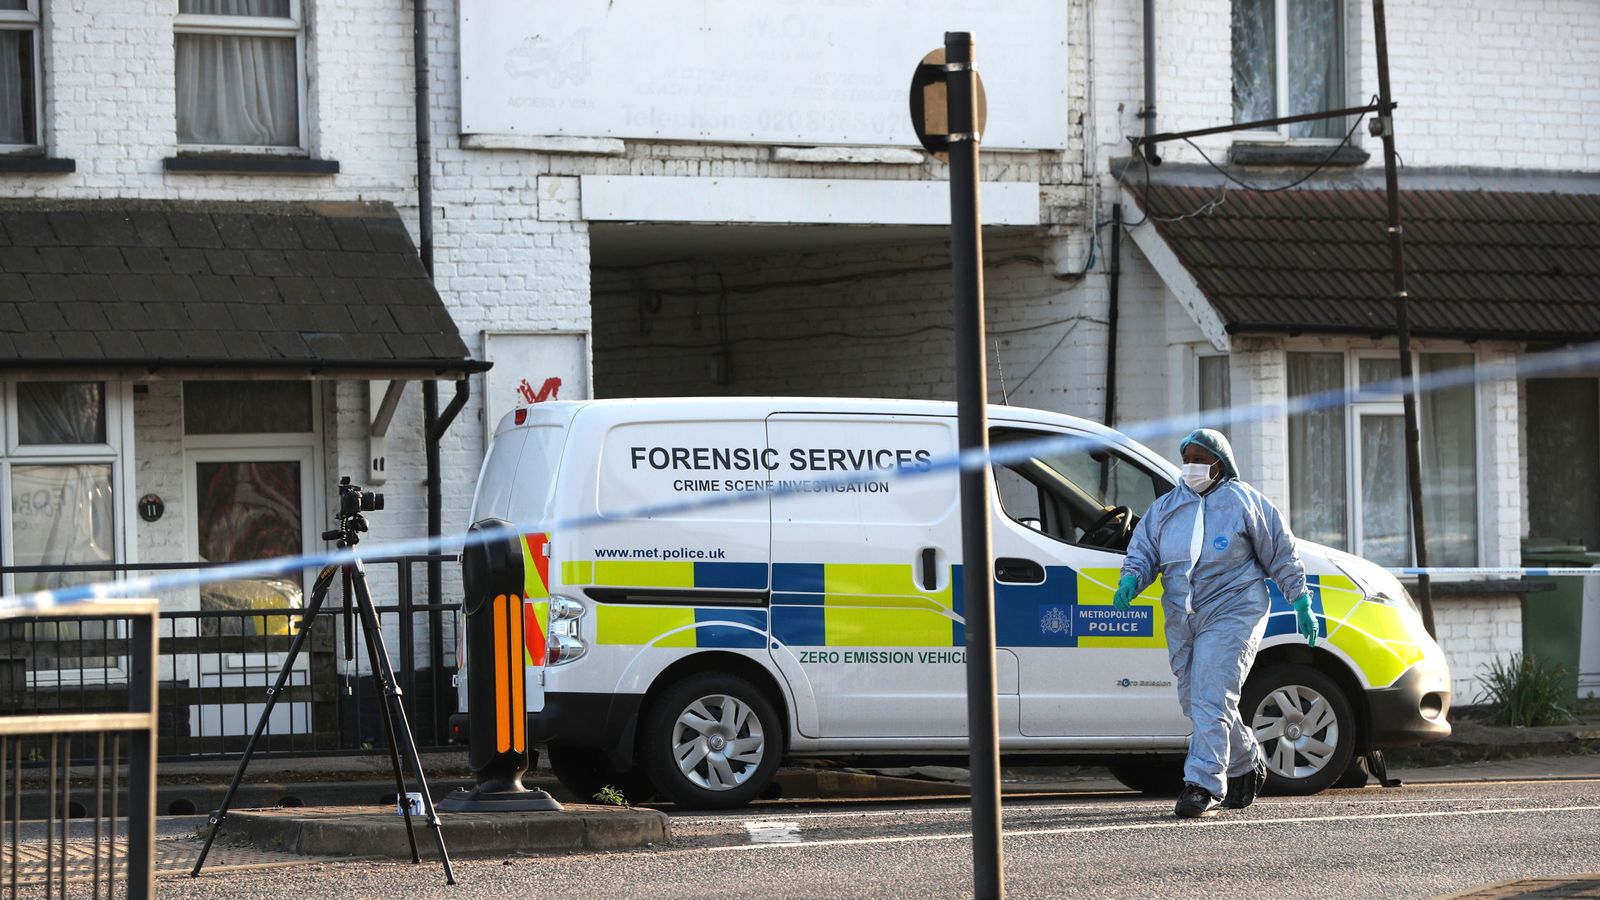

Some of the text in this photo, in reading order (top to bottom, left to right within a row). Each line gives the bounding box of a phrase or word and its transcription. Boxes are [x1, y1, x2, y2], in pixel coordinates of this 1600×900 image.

[631, 447, 932, 473] FORENSIC SERVICES
[673, 479, 889, 493] CRIME SCENE INVESTIGATION
[147, 504, 157, 517] 11
[594, 547, 726, 560] www.met.police.uk
[1079, 610, 1148, 620] METROPOLITAN
[1088, 622, 1139, 632] POLICE
[799, 651, 968, 664] ZERO EMISSION VEHICL
